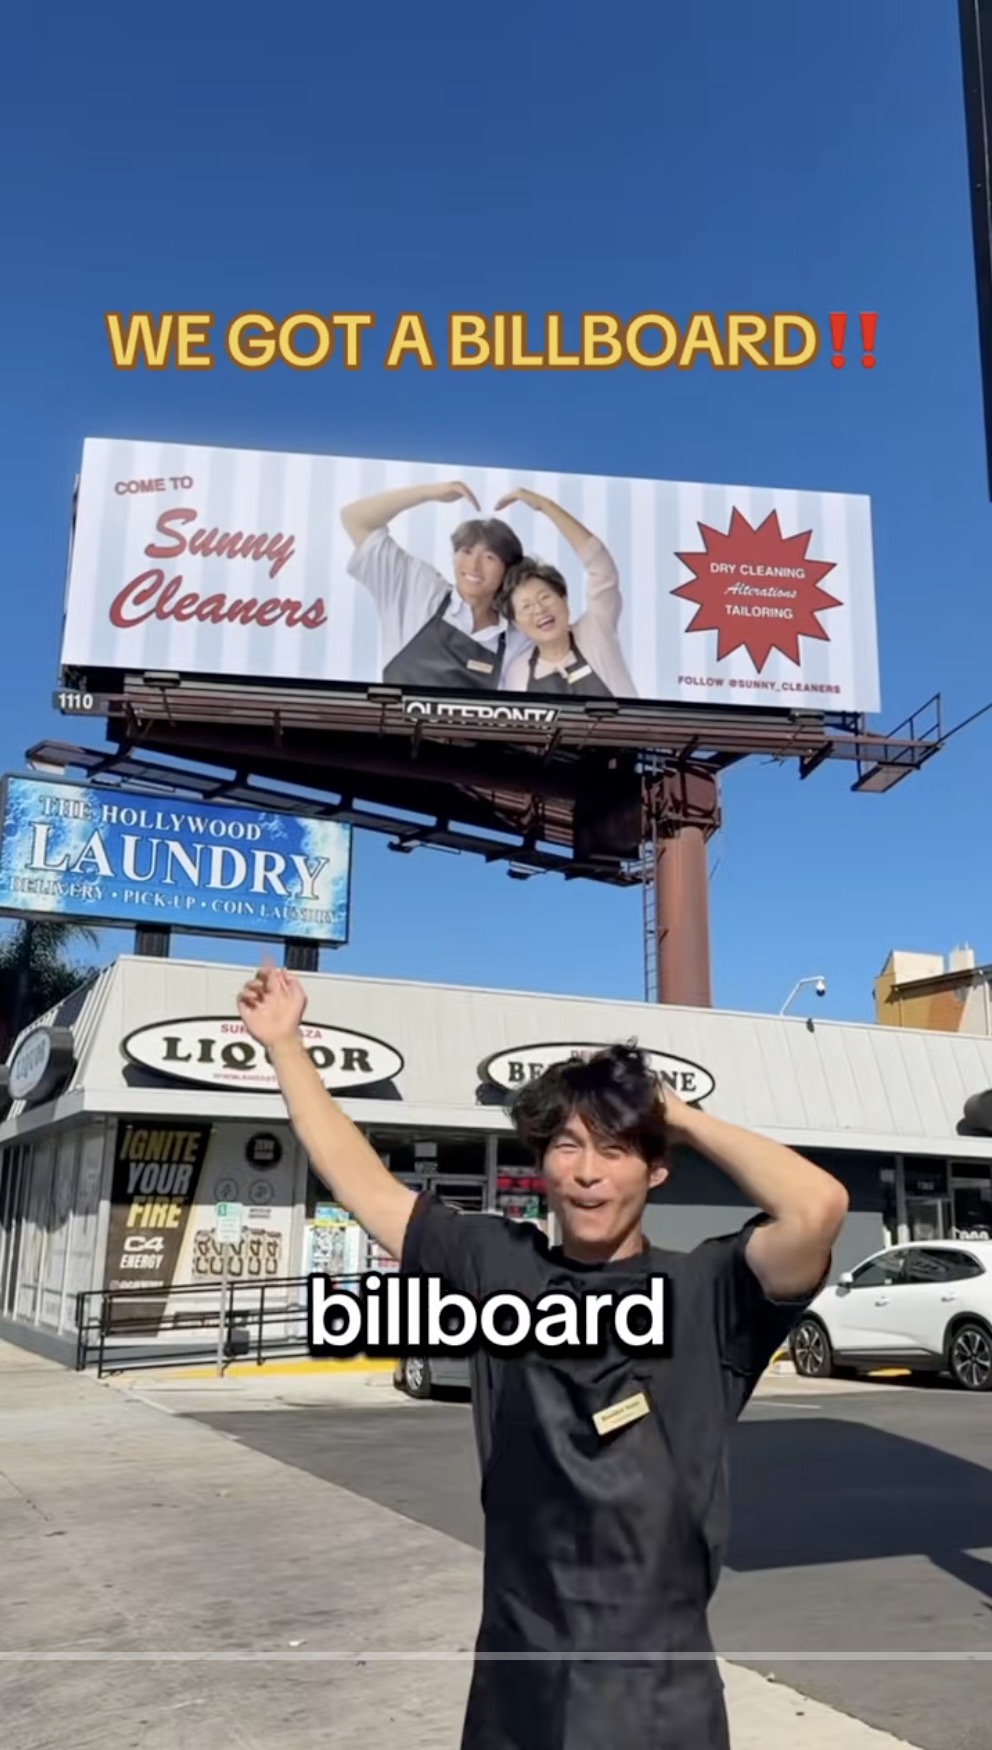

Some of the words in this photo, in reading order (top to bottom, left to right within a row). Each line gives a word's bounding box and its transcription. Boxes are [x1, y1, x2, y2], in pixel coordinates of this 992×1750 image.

[114, 478, 166, 496] COME
[169, 476, 194, 490] TO
[144, 507, 296, 579] Sunny
[709, 562, 736, 574] DRY
[739, 564, 806, 579] CLEANING
[109, 568, 328, 629] Cleaners
[724, 581, 798, 599] Alterations
[725, 604, 794, 620] TAILORING
[58, 693, 94, 709] 1110
[677, 675, 725, 687] FOLLOW
[728, 678, 842, 694] @SUNNY_CLEANERS
[40, 794, 94, 821] THE
[102, 806, 263, 841] HOLLYWOOD
[27, 822, 331, 901] LAUNDRY
[9, 876, 107, 900] DELIVERY
[123, 889, 196, 910] PICK-UP
[211, 898, 255, 915] COIN
[259, 903, 338, 924] LAUNDRY
[162, 1036, 374, 1073] LIQOR
[120, 1128, 202, 1162] IGNITE
[127, 1162, 194, 1195] YOUR
[127, 1195, 188, 1229] FIRE
[120, 1253, 164, 1269] ENERGY
[123, 1236, 164, 1252] C4
[247, 1239, 262, 1276] C4
[265, 1240, 279, 1275] C4
